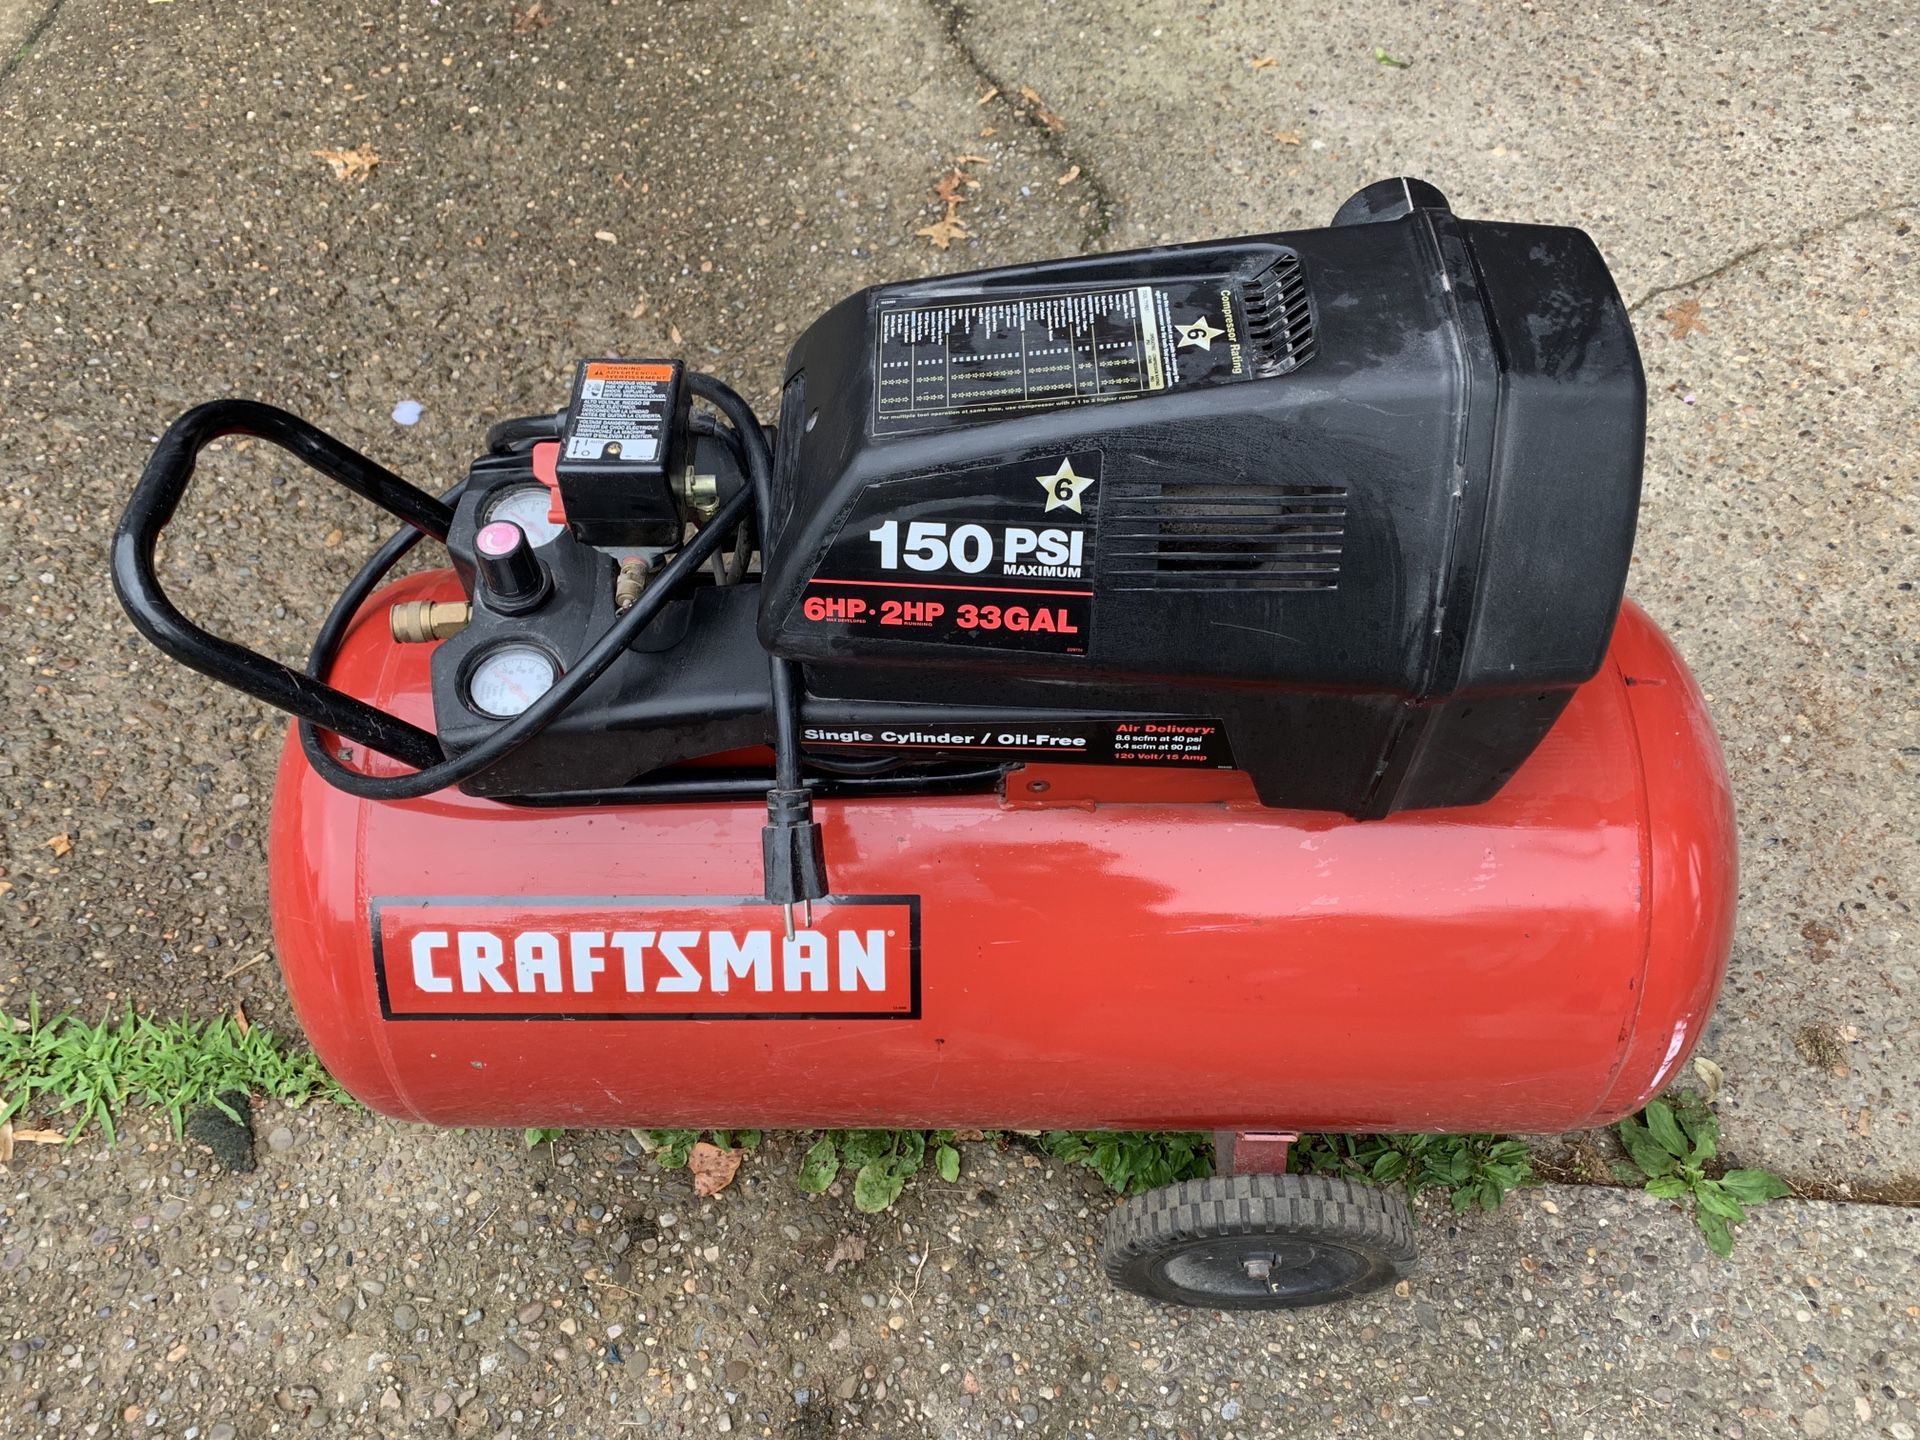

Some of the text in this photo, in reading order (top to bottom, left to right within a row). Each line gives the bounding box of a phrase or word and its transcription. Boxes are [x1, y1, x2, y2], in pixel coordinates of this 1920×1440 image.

[1187, 328, 1207, 340] 6
[1220, 290, 1243, 374] Compressor Rating
[1054, 478, 1073, 501] 6
[869, 520, 1084, 574] 150 PSI
[1003, 564, 1081, 578] MAXIMUM
[880, 600, 944, 626] 2HP
[956, 604, 1077, 634] 33GAL
[804, 729, 1086, 747] Single Cylinder / Oil-Free
[1116, 724, 1216, 734] Air Delivery:
[410, 930, 886, 992] CRAFTSMAN
